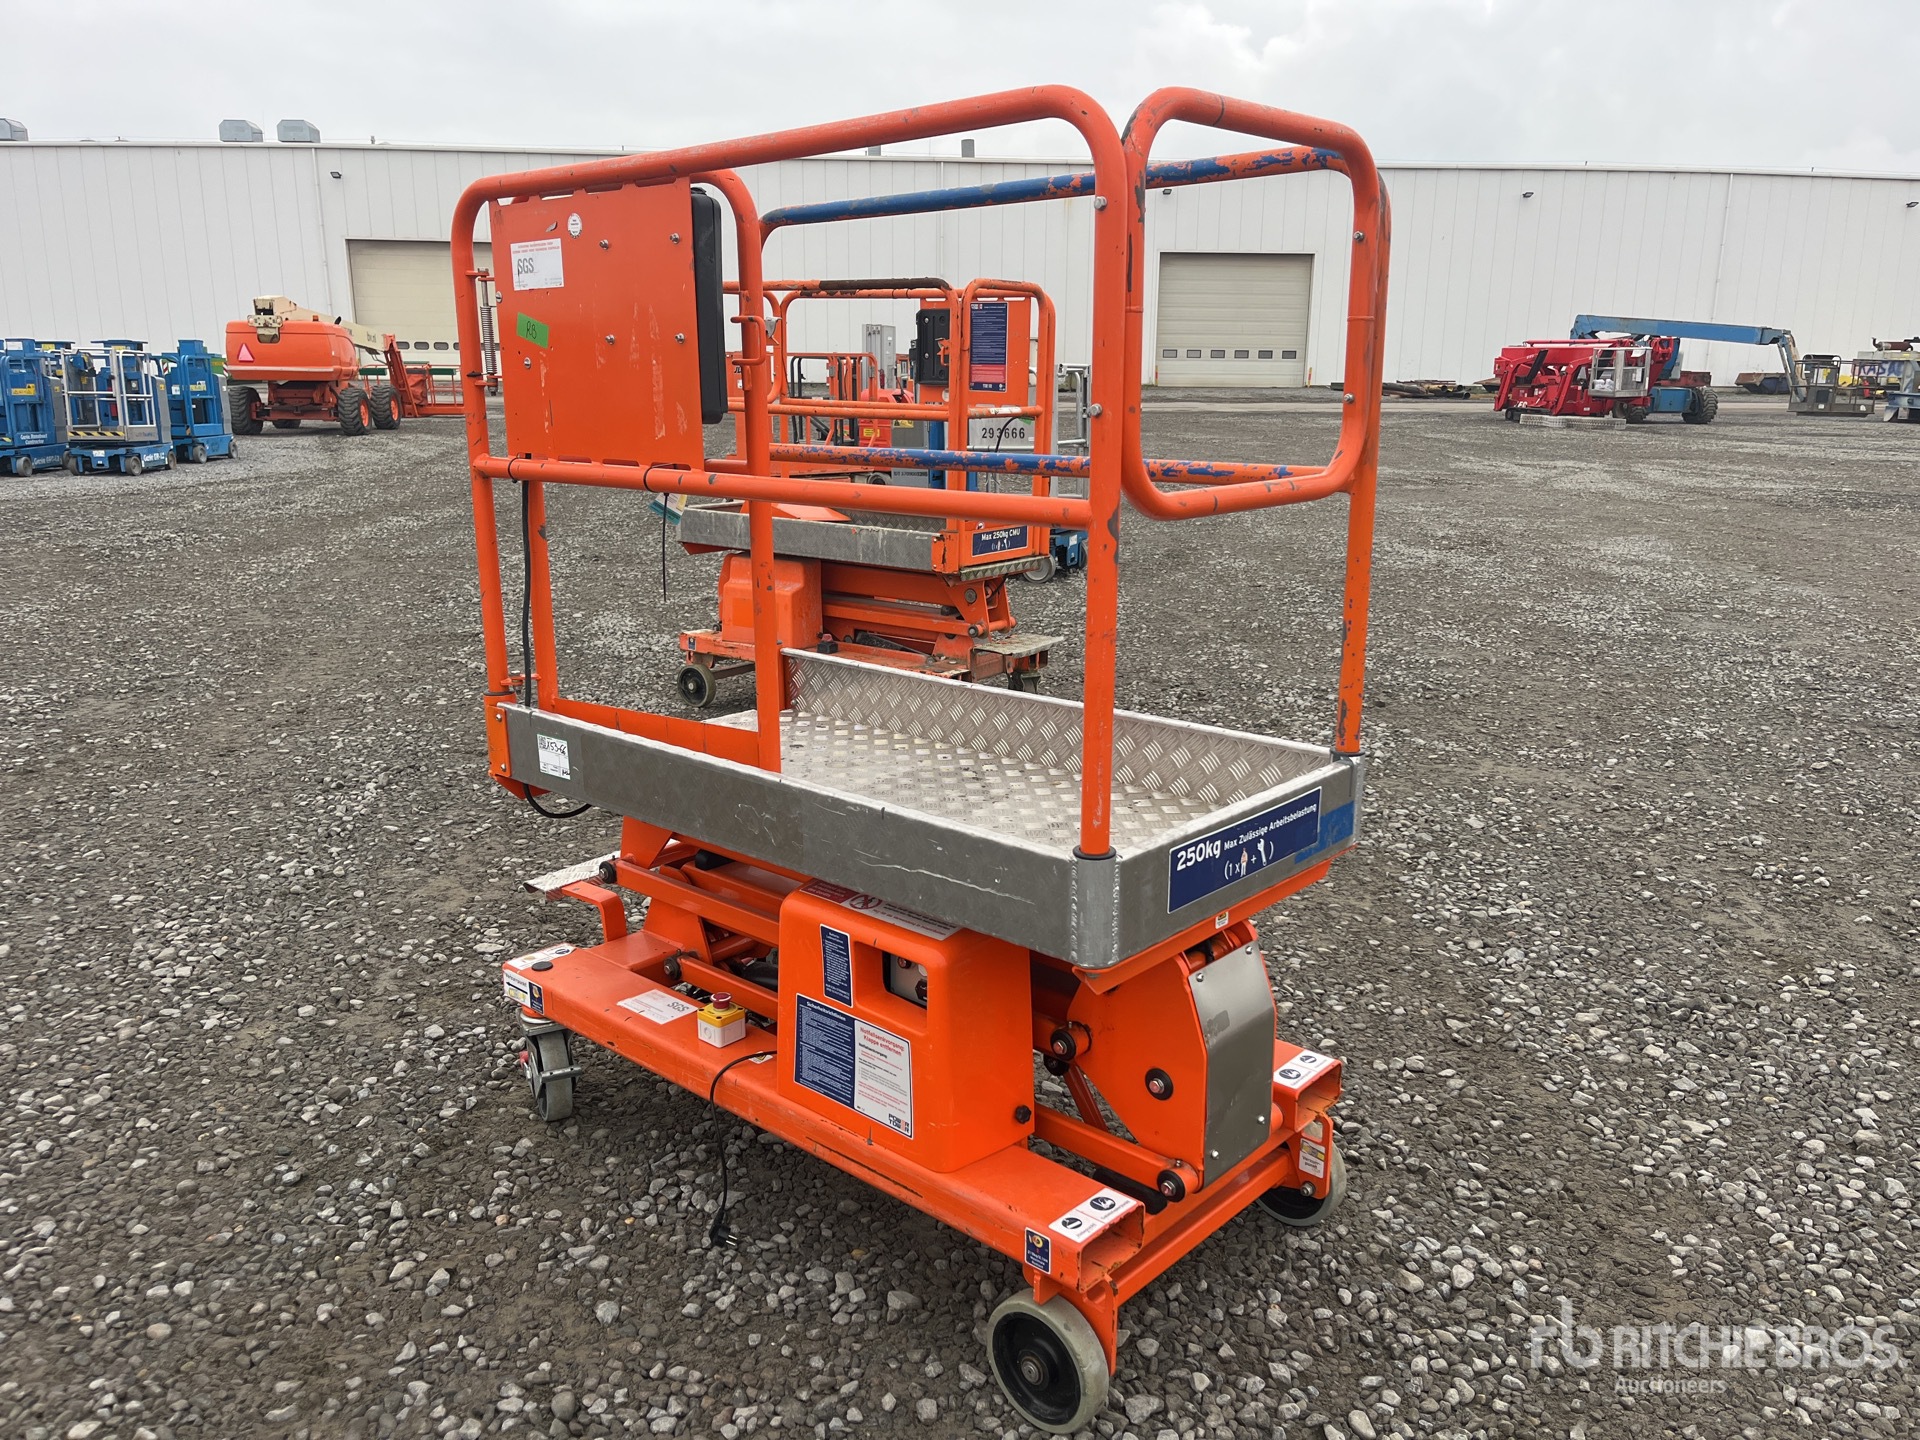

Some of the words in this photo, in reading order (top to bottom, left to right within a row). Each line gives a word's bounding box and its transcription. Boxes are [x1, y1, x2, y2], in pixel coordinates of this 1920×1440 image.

[517, 257, 535, 275] SGS
[981, 427, 1025, 439] 293666
[1009, 528, 1021, 537] CMU
[1176, 839, 1221, 872] 250kg
[1223, 840, 1238, 851] Max
[1238, 827, 1268, 844] Zulässige
[1268, 803, 1317, 832] Arbeitsbelastung
